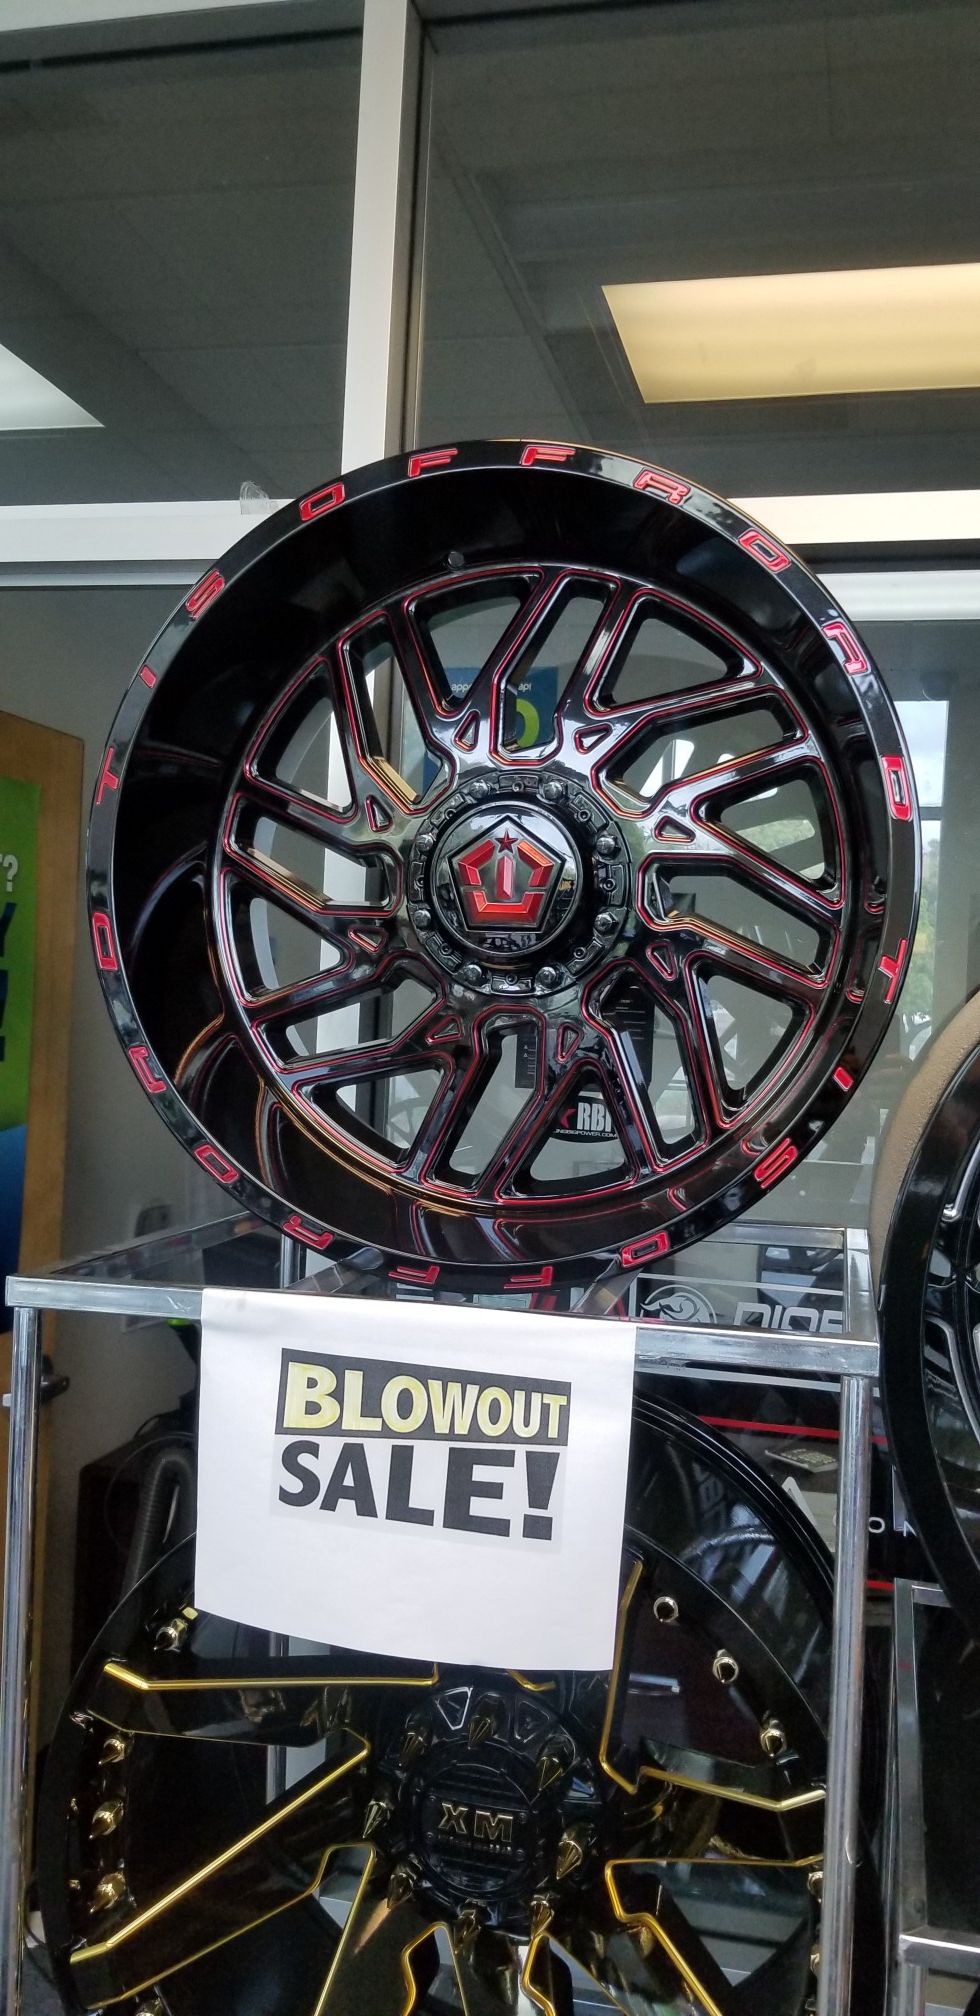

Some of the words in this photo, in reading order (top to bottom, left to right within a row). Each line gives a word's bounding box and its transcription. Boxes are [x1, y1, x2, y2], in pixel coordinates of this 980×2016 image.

[283, 1361, 568, 1439] BLOWOUT
[278, 1440, 561, 1541] SALE!
[438, 1802, 514, 1843] XM
